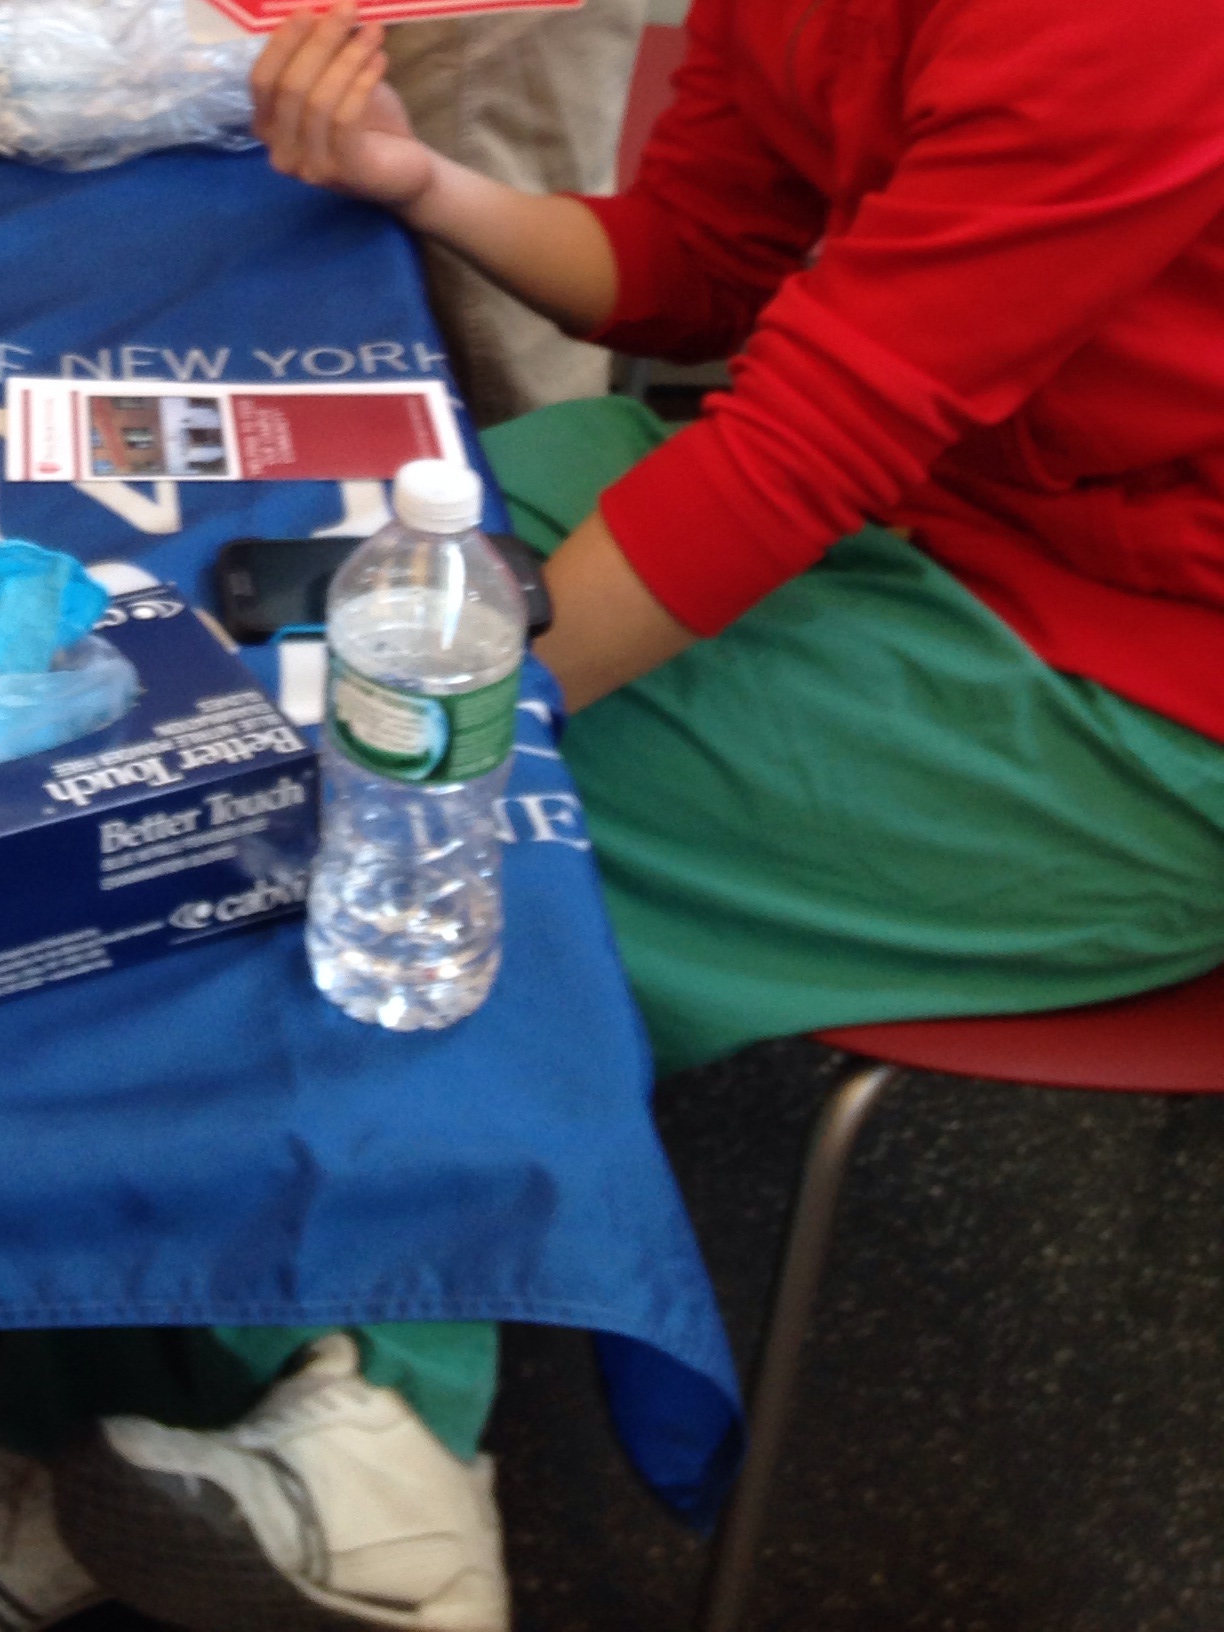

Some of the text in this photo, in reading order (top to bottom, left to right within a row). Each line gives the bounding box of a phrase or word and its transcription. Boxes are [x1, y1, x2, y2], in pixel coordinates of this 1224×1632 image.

[60, 342, 231, 382] NEW
[178, 725, 308, 770] Better
[41, 756, 185, 807] Touch
[99, 808, 203, 855] Better
[204, 775, 307, 826] Touch
